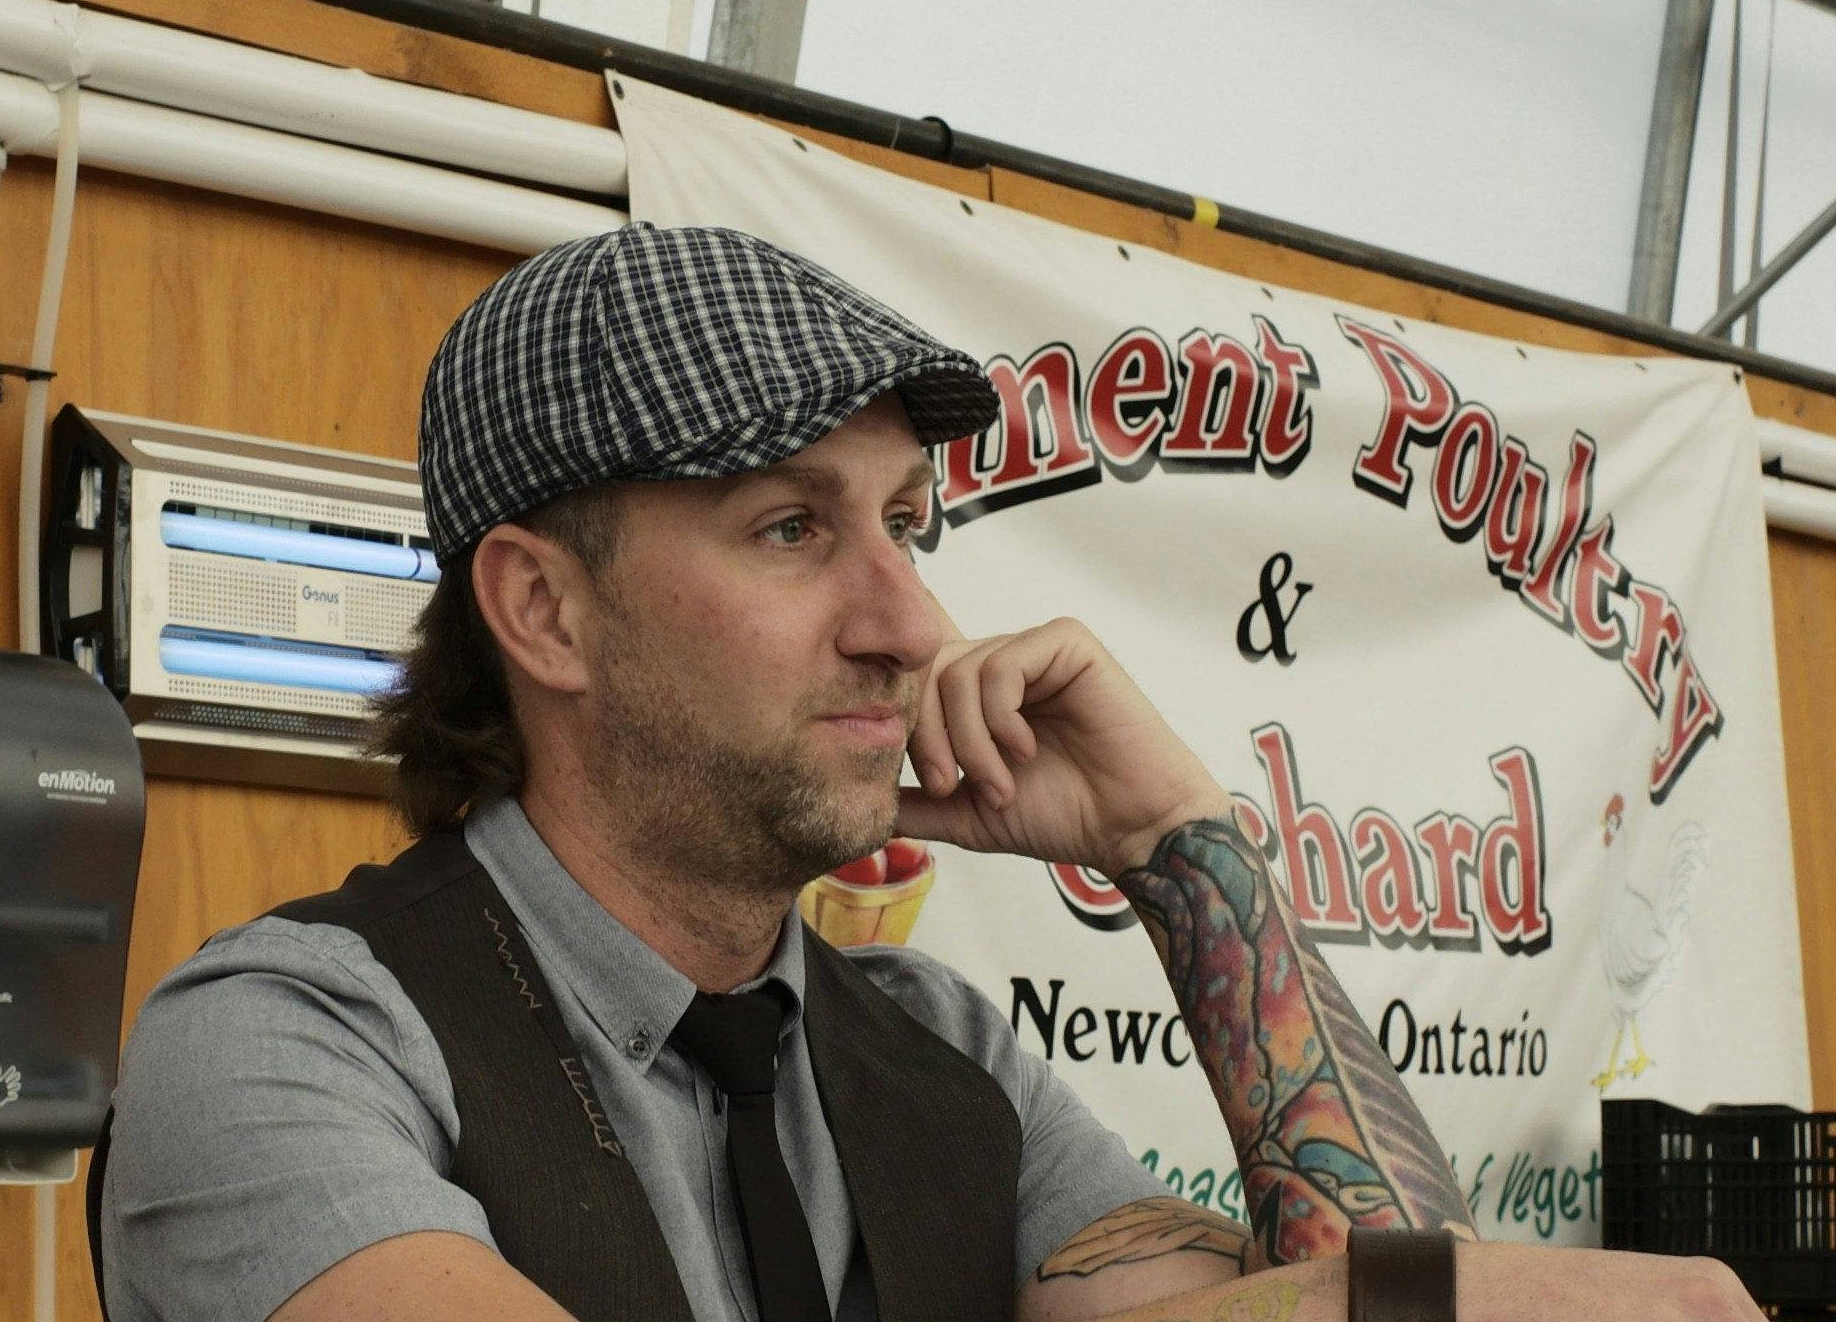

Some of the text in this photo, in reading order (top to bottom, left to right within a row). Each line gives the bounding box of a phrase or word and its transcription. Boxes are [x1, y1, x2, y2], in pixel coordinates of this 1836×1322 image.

[915, 314, 1725, 806] ment Poultry
[1235, 551, 1313, 666] &
[38, 770, 115, 794] enMotion
[1380, 997, 1547, 1078] Ontario
[1498, 1150, 1603, 1239] Veget
